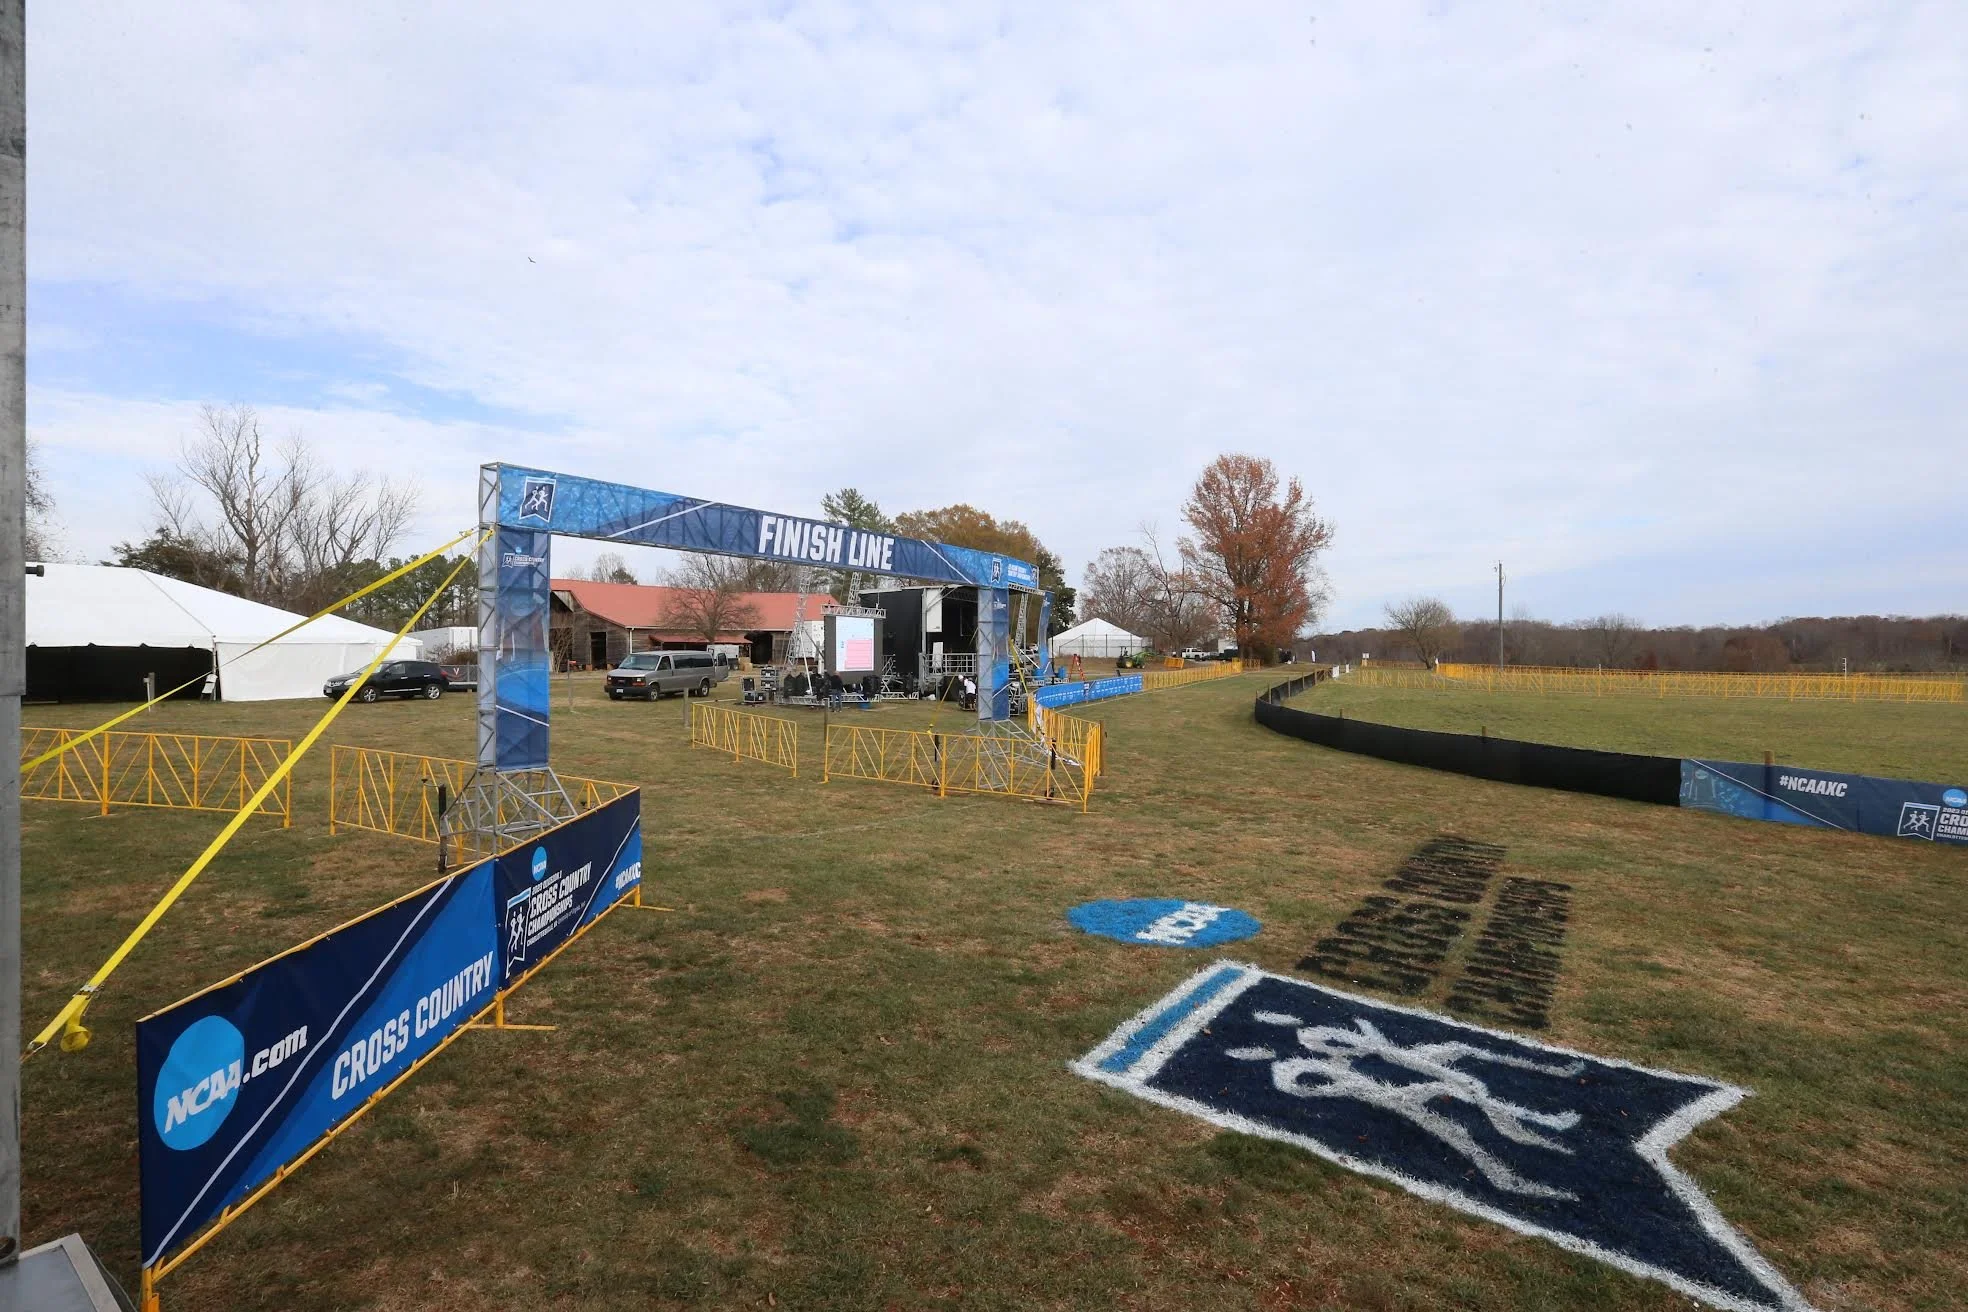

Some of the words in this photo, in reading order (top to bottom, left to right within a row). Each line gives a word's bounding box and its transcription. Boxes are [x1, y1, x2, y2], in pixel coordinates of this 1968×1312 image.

[758, 514, 843, 564] FINISH
[848, 531, 895, 571] LINE
[1779, 775, 1848, 798] #NCAAXC
[527, 894, 573, 937] CHAMPIONSHIPS
[530, 886, 558, 919] CROSS
[558, 862, 592, 905] COUNTRY
[331, 1007, 409, 1101] CROSS
[414, 950, 494, 1039] COUNTRY
[164, 1024, 308, 1134] NCAA.com
